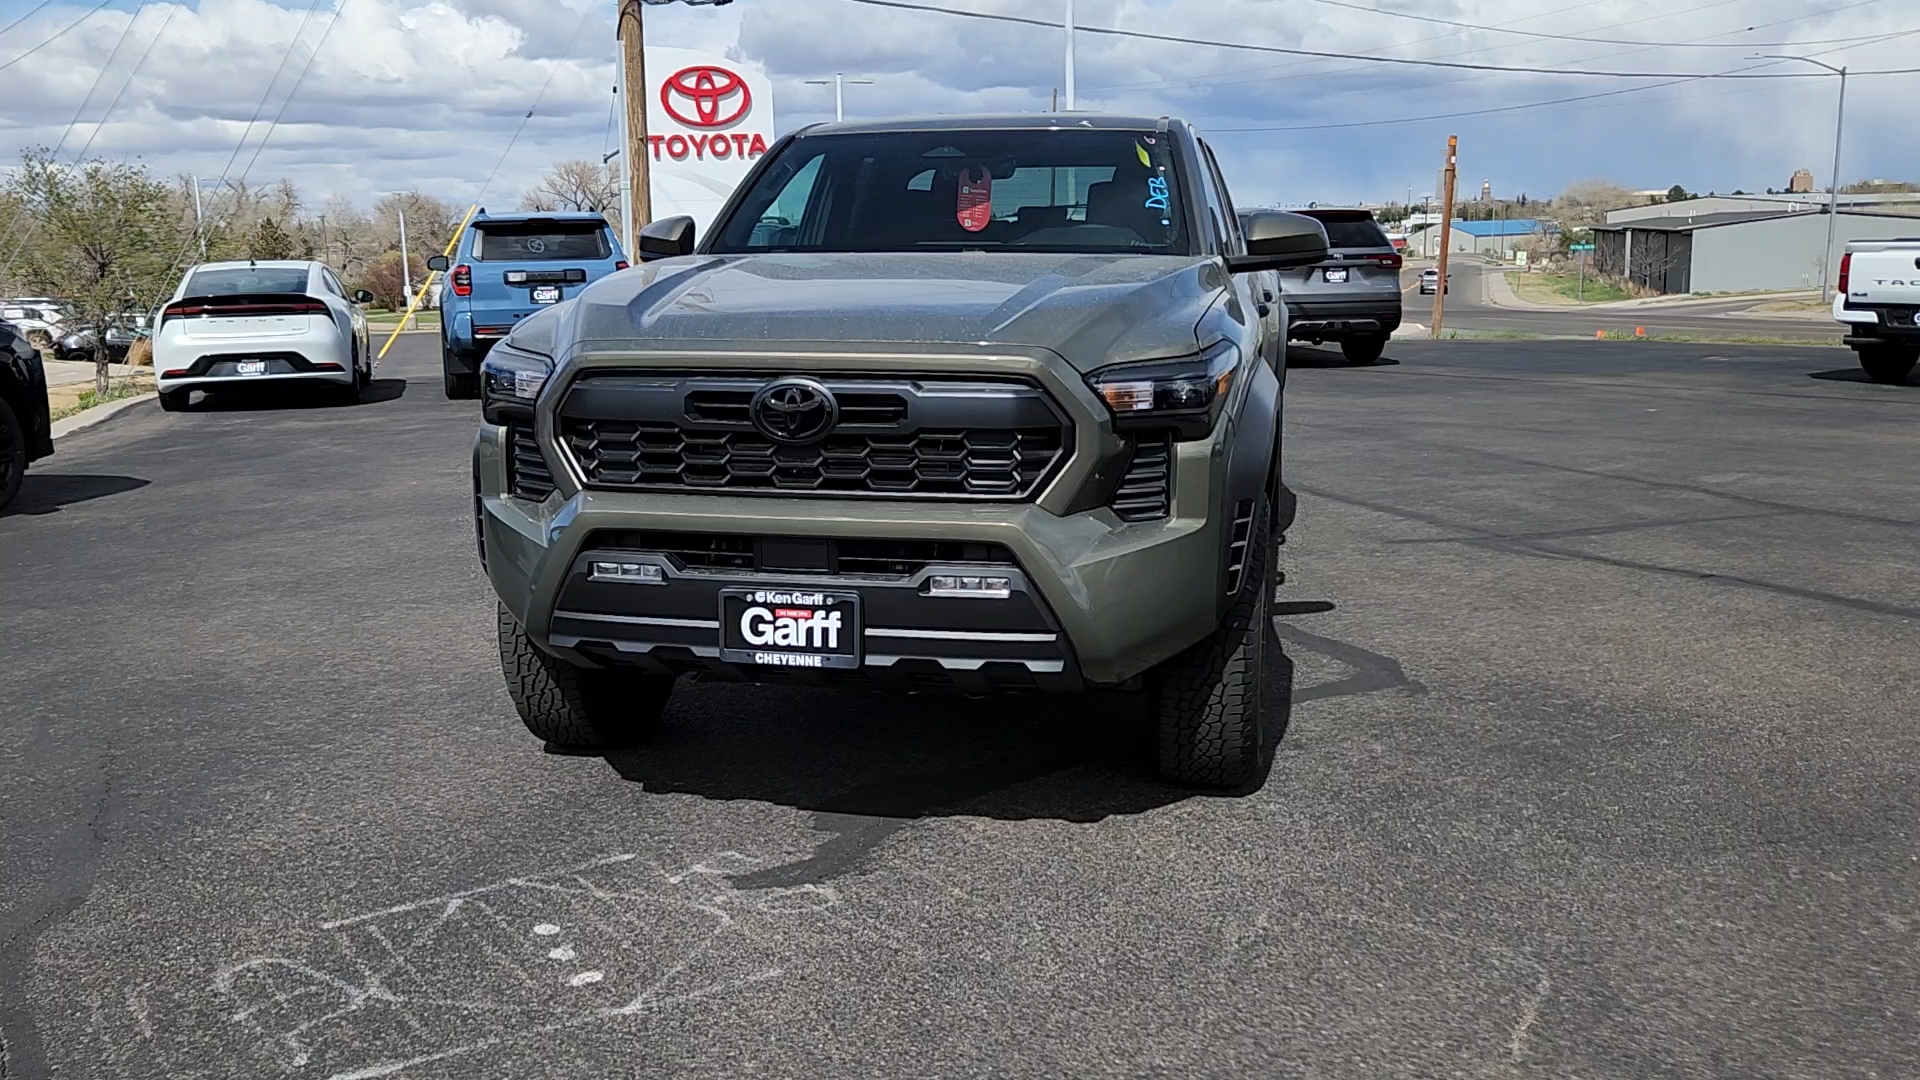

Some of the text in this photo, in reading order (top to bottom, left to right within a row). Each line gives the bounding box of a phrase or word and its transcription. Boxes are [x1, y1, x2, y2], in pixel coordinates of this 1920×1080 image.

[647, 133, 768, 161] TOYOTA
[1145, 176, 1169, 209] DEB
[766, 592, 791, 604] Ken
[792, 593, 824, 606] Garff
[740, 606, 842, 648] Garff
[754, 652, 822, 668] CHEYENNE
